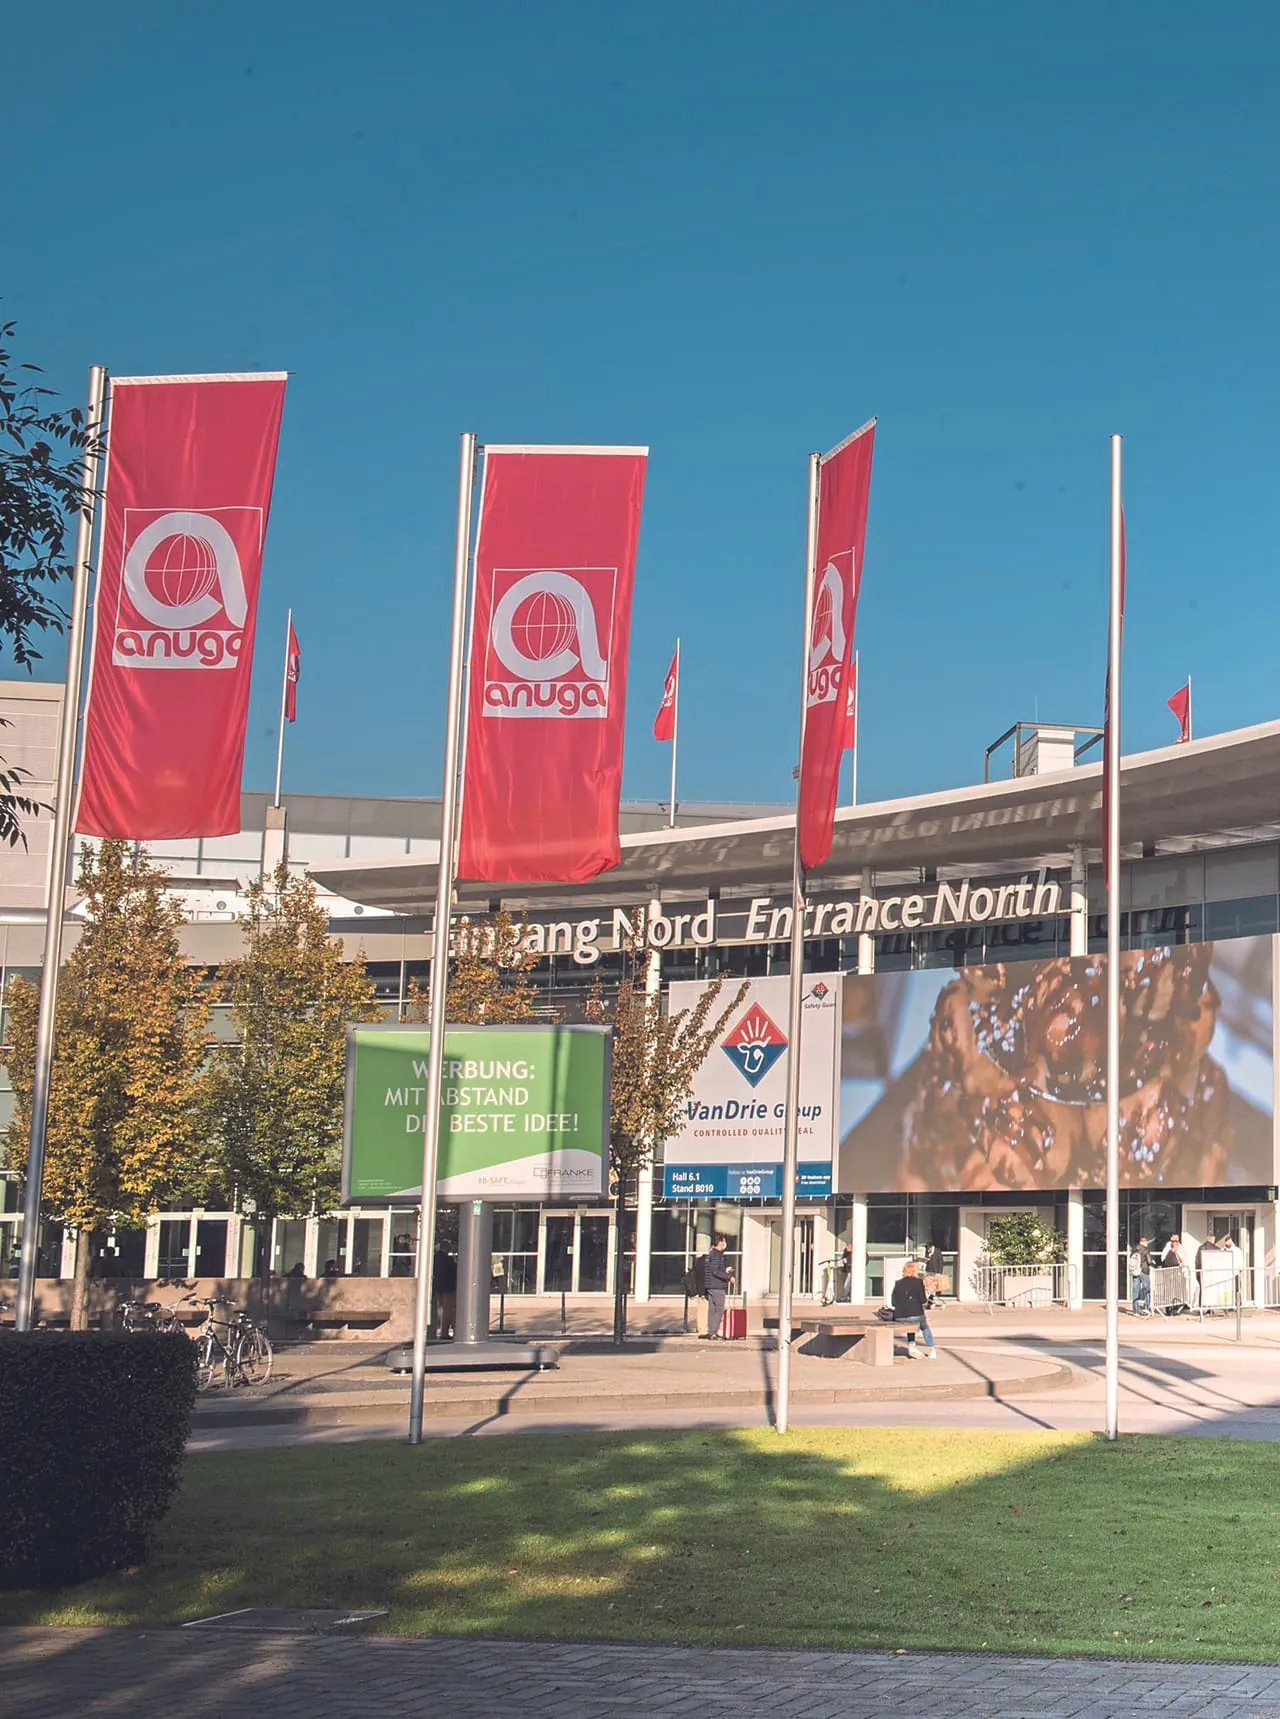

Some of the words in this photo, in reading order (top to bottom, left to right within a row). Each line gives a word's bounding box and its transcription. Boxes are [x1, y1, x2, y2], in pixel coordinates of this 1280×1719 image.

[485, 683, 607, 715] anuga
[612, 898, 716, 949] Nord
[931, 867, 1064, 925] North
[384, 1087, 426, 1106] MIT
[440, 1087, 529, 1106] BSTAND
[687, 1099, 768, 1121] VanDrie
[773, 1103, 822, 1121] Gup
[406, 1114, 427, 1133] DI
[450, 1113, 516, 1133] BESTE
[524, 1113, 579, 1132] IDEE!
[694, 1128, 749, 1138] CONTROLLED
[751, 1126, 784, 1137] QUALIT
[797, 1126, 814, 1135] EAL
[547, 1168, 594, 1177] FRANKE
[672, 1172, 688, 1182] Hall
[688, 1172, 700, 1181] 6.1
[671, 1184, 694, 1194] Stand
